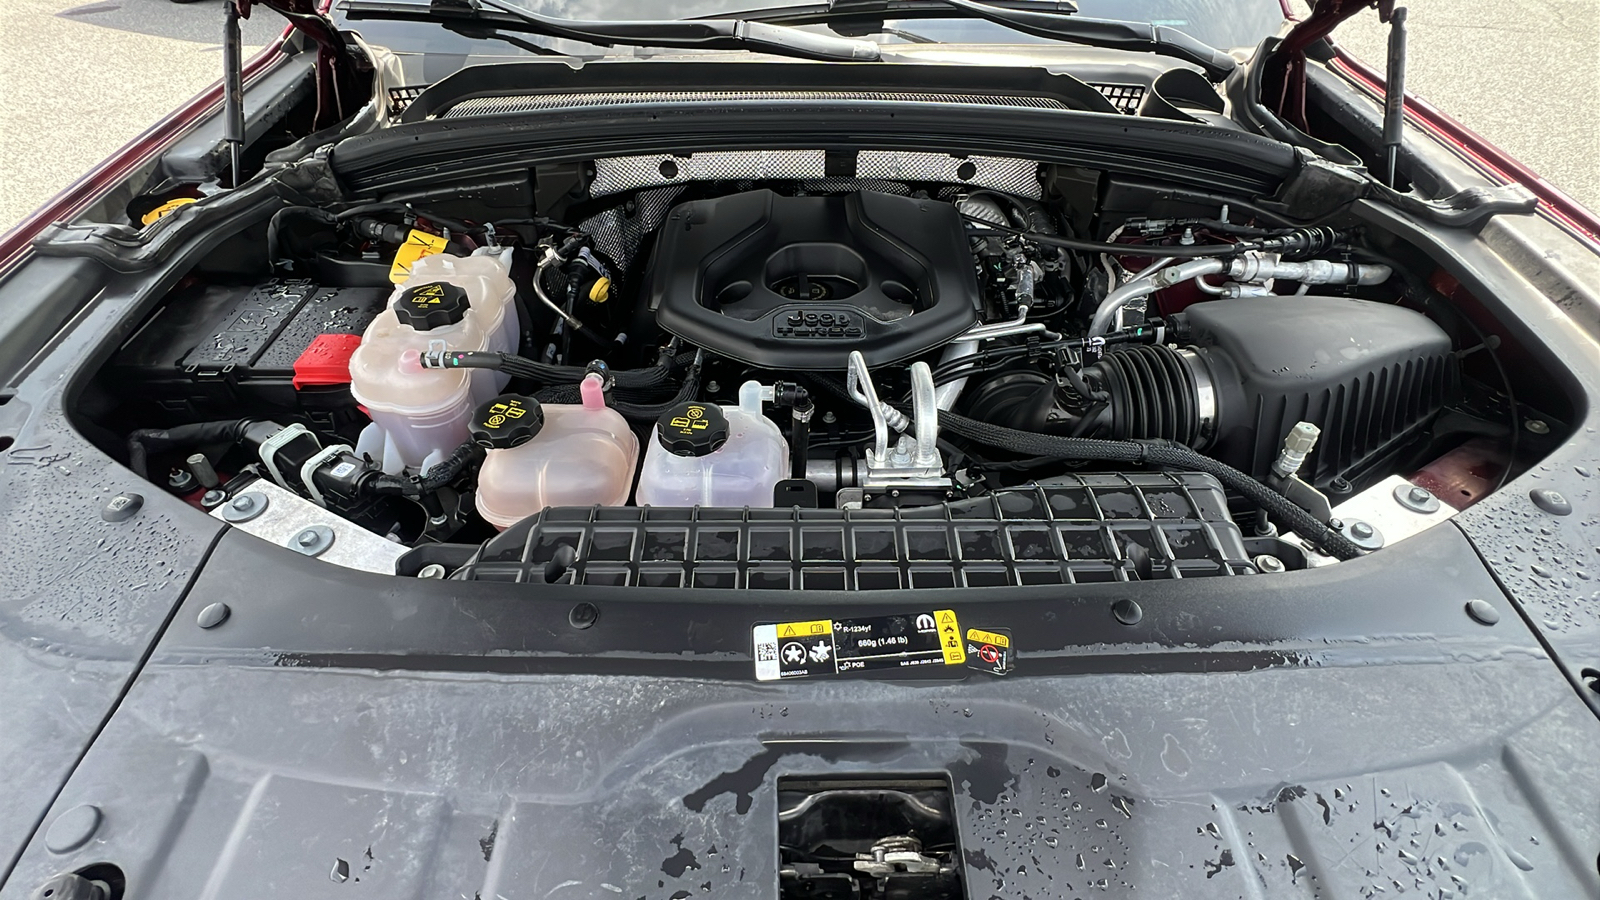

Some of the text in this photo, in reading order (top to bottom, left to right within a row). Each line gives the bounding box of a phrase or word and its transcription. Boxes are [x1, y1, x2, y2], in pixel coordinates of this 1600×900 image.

[787, 310, 850, 327] Jeep
[777, 327, 861, 337] TURBO
[843, 624, 871, 634] R-1234yf
[897, 635, 908, 646] lb)
